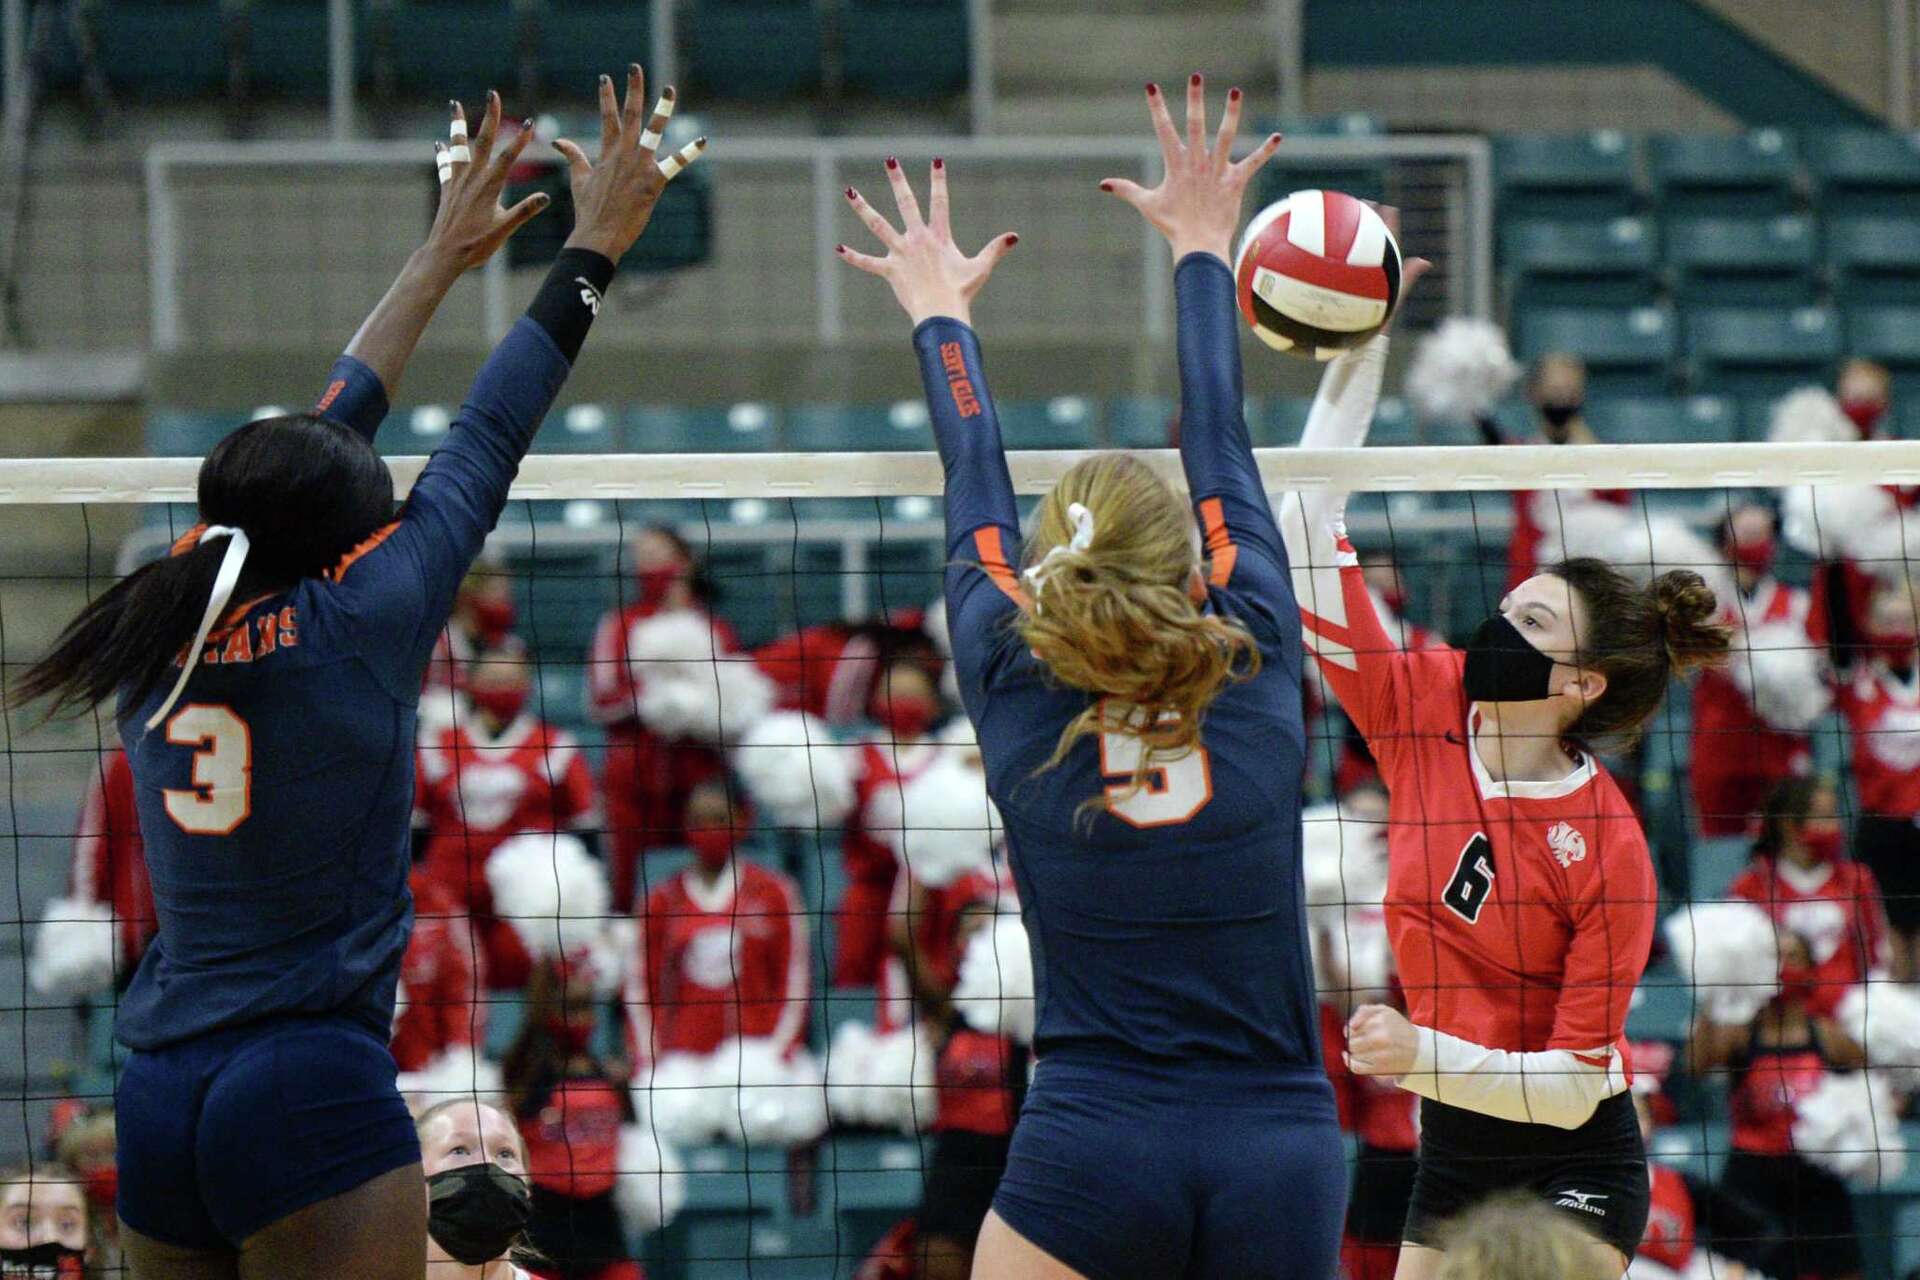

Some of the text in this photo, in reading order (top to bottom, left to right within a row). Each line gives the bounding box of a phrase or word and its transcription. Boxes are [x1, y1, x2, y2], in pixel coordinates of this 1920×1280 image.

[162, 703, 254, 837] 3
[1098, 695, 1214, 830] 5
[1441, 831, 1495, 926] 6
